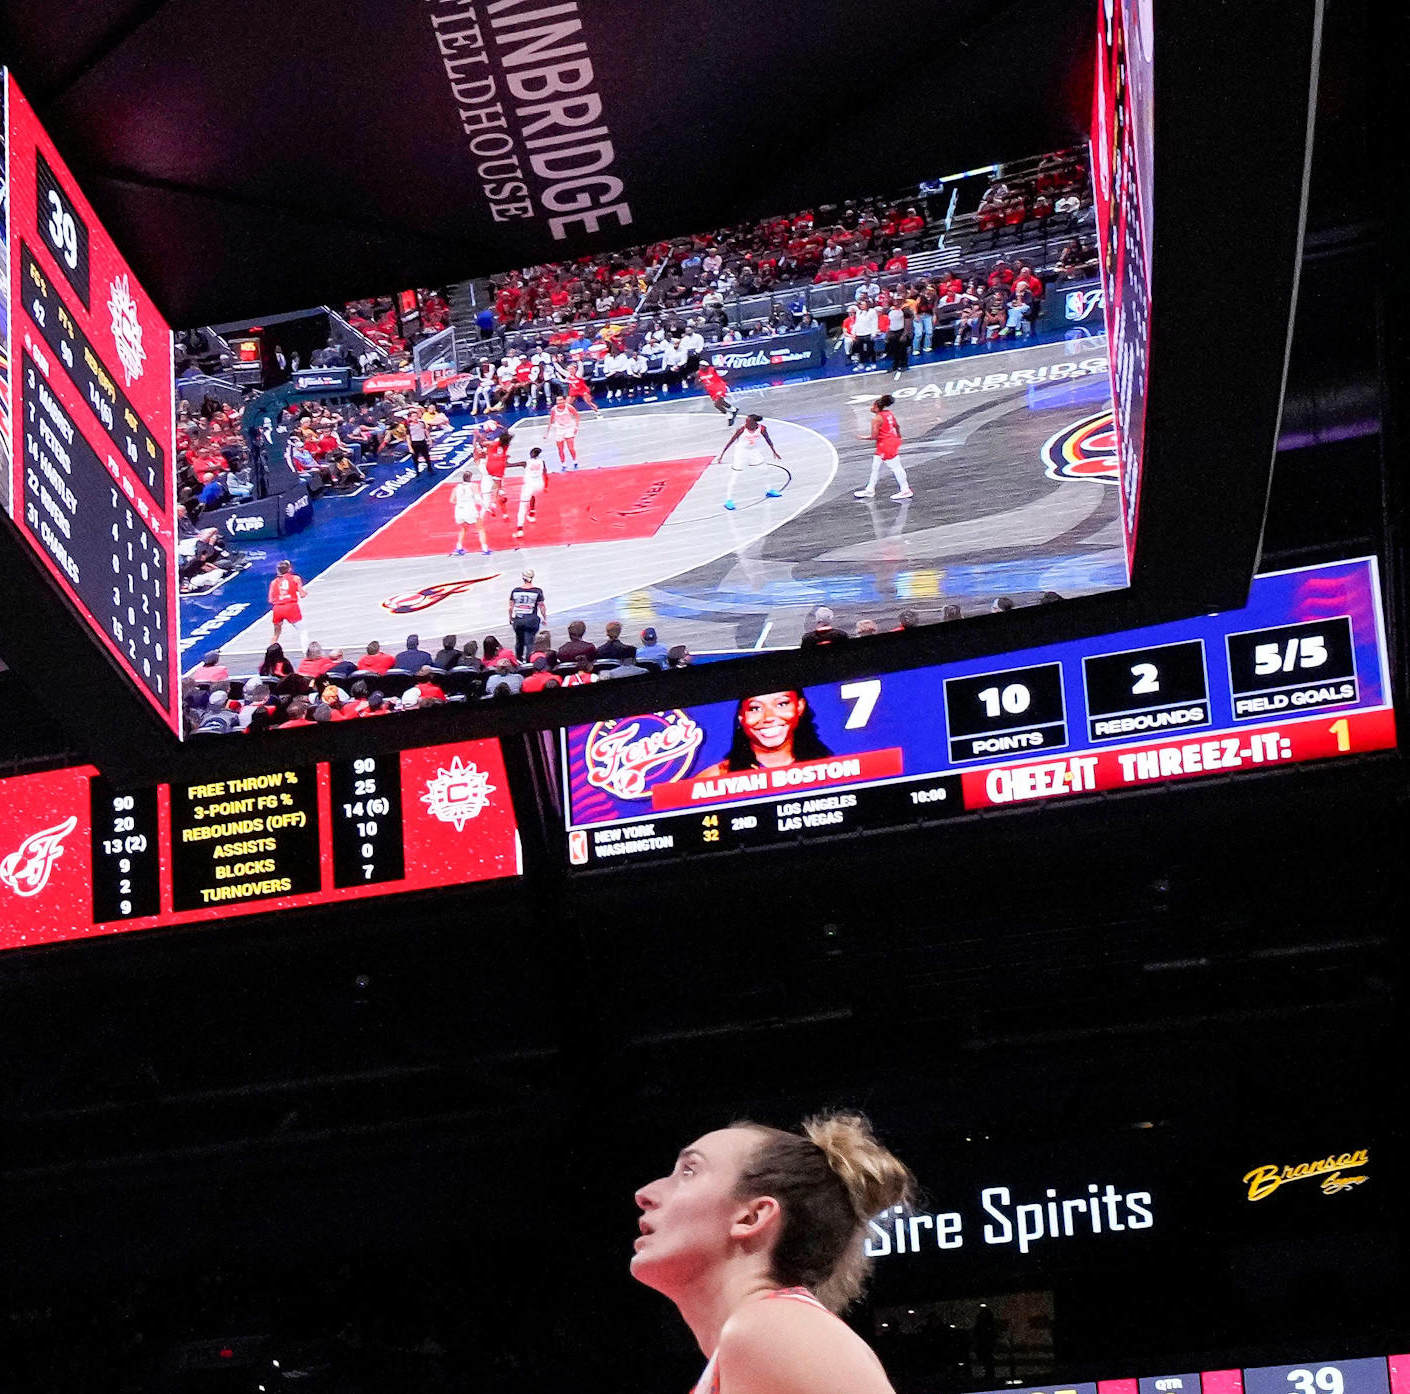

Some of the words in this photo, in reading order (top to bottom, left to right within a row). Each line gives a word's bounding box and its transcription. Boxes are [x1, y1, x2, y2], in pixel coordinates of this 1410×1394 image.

[425, 0, 535, 223] IELDHOUSE
[48, 190, 77, 269] 39
[891, 358, 1108, 399] GAINBRIDG
[41, 521, 80, 584] CHARLES
[1255, 636, 1328, 675] 5/5
[1131, 663, 1160, 695] 2
[840, 680, 882, 729] 7
[978, 683, 1031, 718] 10
[1236, 693, 1290, 715] FIELD
[1292, 684, 1354, 707] GOALS
[1095, 707, 1204, 736] REBOUNDS
[591, 718, 703, 783] Fever
[972, 732, 1044, 755] POINTS
[1119, 732, 1292, 783] THREEZ-IT:
[1329, 719, 1351, 752] 1
[354, 758, 376, 774] 90
[691, 768, 768, 800] ALIYAH
[770, 759, 861, 789] BOSTON
[188, 783, 224, 800] FREE
[227, 776, 282, 794] THROW
[284, 771, 298, 786] %
[355, 779, 376, 795] 25
[113, 796, 134, 812] 90
[194, 800, 254, 820] 3-POINT
[257, 796, 278, 811] FG
[279, 793, 293, 807] %
[343, 801, 364, 818] 14
[366, 798, 389, 817] (6)
[595, 828, 620, 844] NEW
[622, 824, 655, 842] YORK
[701, 815, 719, 829] 44
[731, 816, 757, 831] 2ND
[777, 801, 800, 817] LOS
[802, 795, 857, 814] ANGELES
[910, 788, 947, 804] 10:00
[114, 817, 135, 832] 20
[183, 820, 263, 843] REBOUNDS
[266, 811, 306, 833] (OFF)
[356, 822, 378, 838] 10
[595, 836, 673, 858] WASHINGTON
[702, 829, 720, 843] 32
[778, 816, 800, 832] LAS
[802, 811, 843, 829] VEGAS
[103, 839, 123, 854] 13
[125, 835, 147, 853] (2)
[212, 837, 276, 860] ASSISTS
[361, 843, 374, 859] 0
[118, 859, 131, 874] 9
[215, 859, 275, 880] BLOCKS
[362, 864, 374, 880] 7
[119, 880, 131, 894] 2
[201, 877, 291, 903] TURNOVERS
[120, 900, 132, 915] 9
[1243, 1149, 1368, 1201] Branson
[865, 1205, 963, 1258] Sire
[982, 1184, 1154, 1254] Spirits
[1155, 1377, 1183, 1392] QTR
